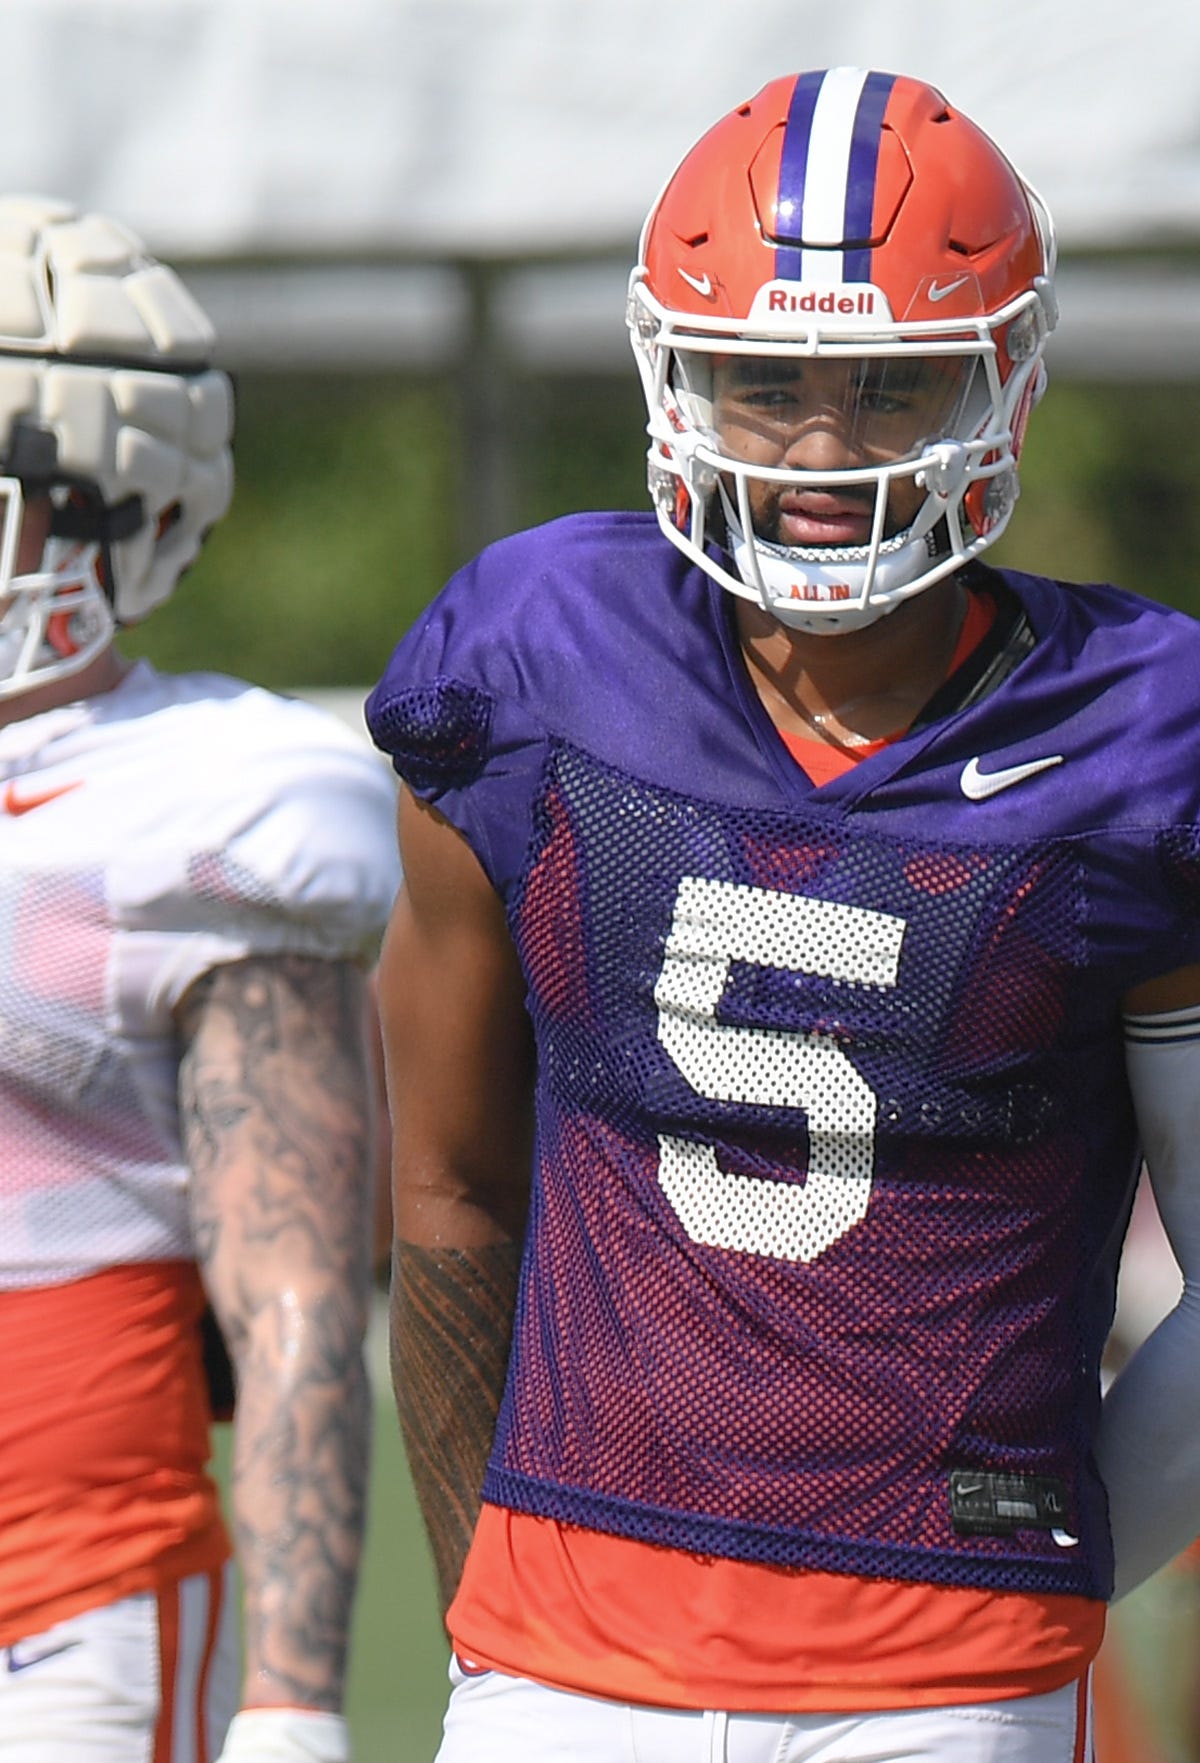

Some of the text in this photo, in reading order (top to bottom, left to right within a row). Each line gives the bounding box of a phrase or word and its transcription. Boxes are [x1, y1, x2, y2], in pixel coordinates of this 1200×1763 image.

[768, 290, 874, 315] Riddell
[790, 584, 851, 601] ALL IN
[654, 876, 907, 1264] 5
